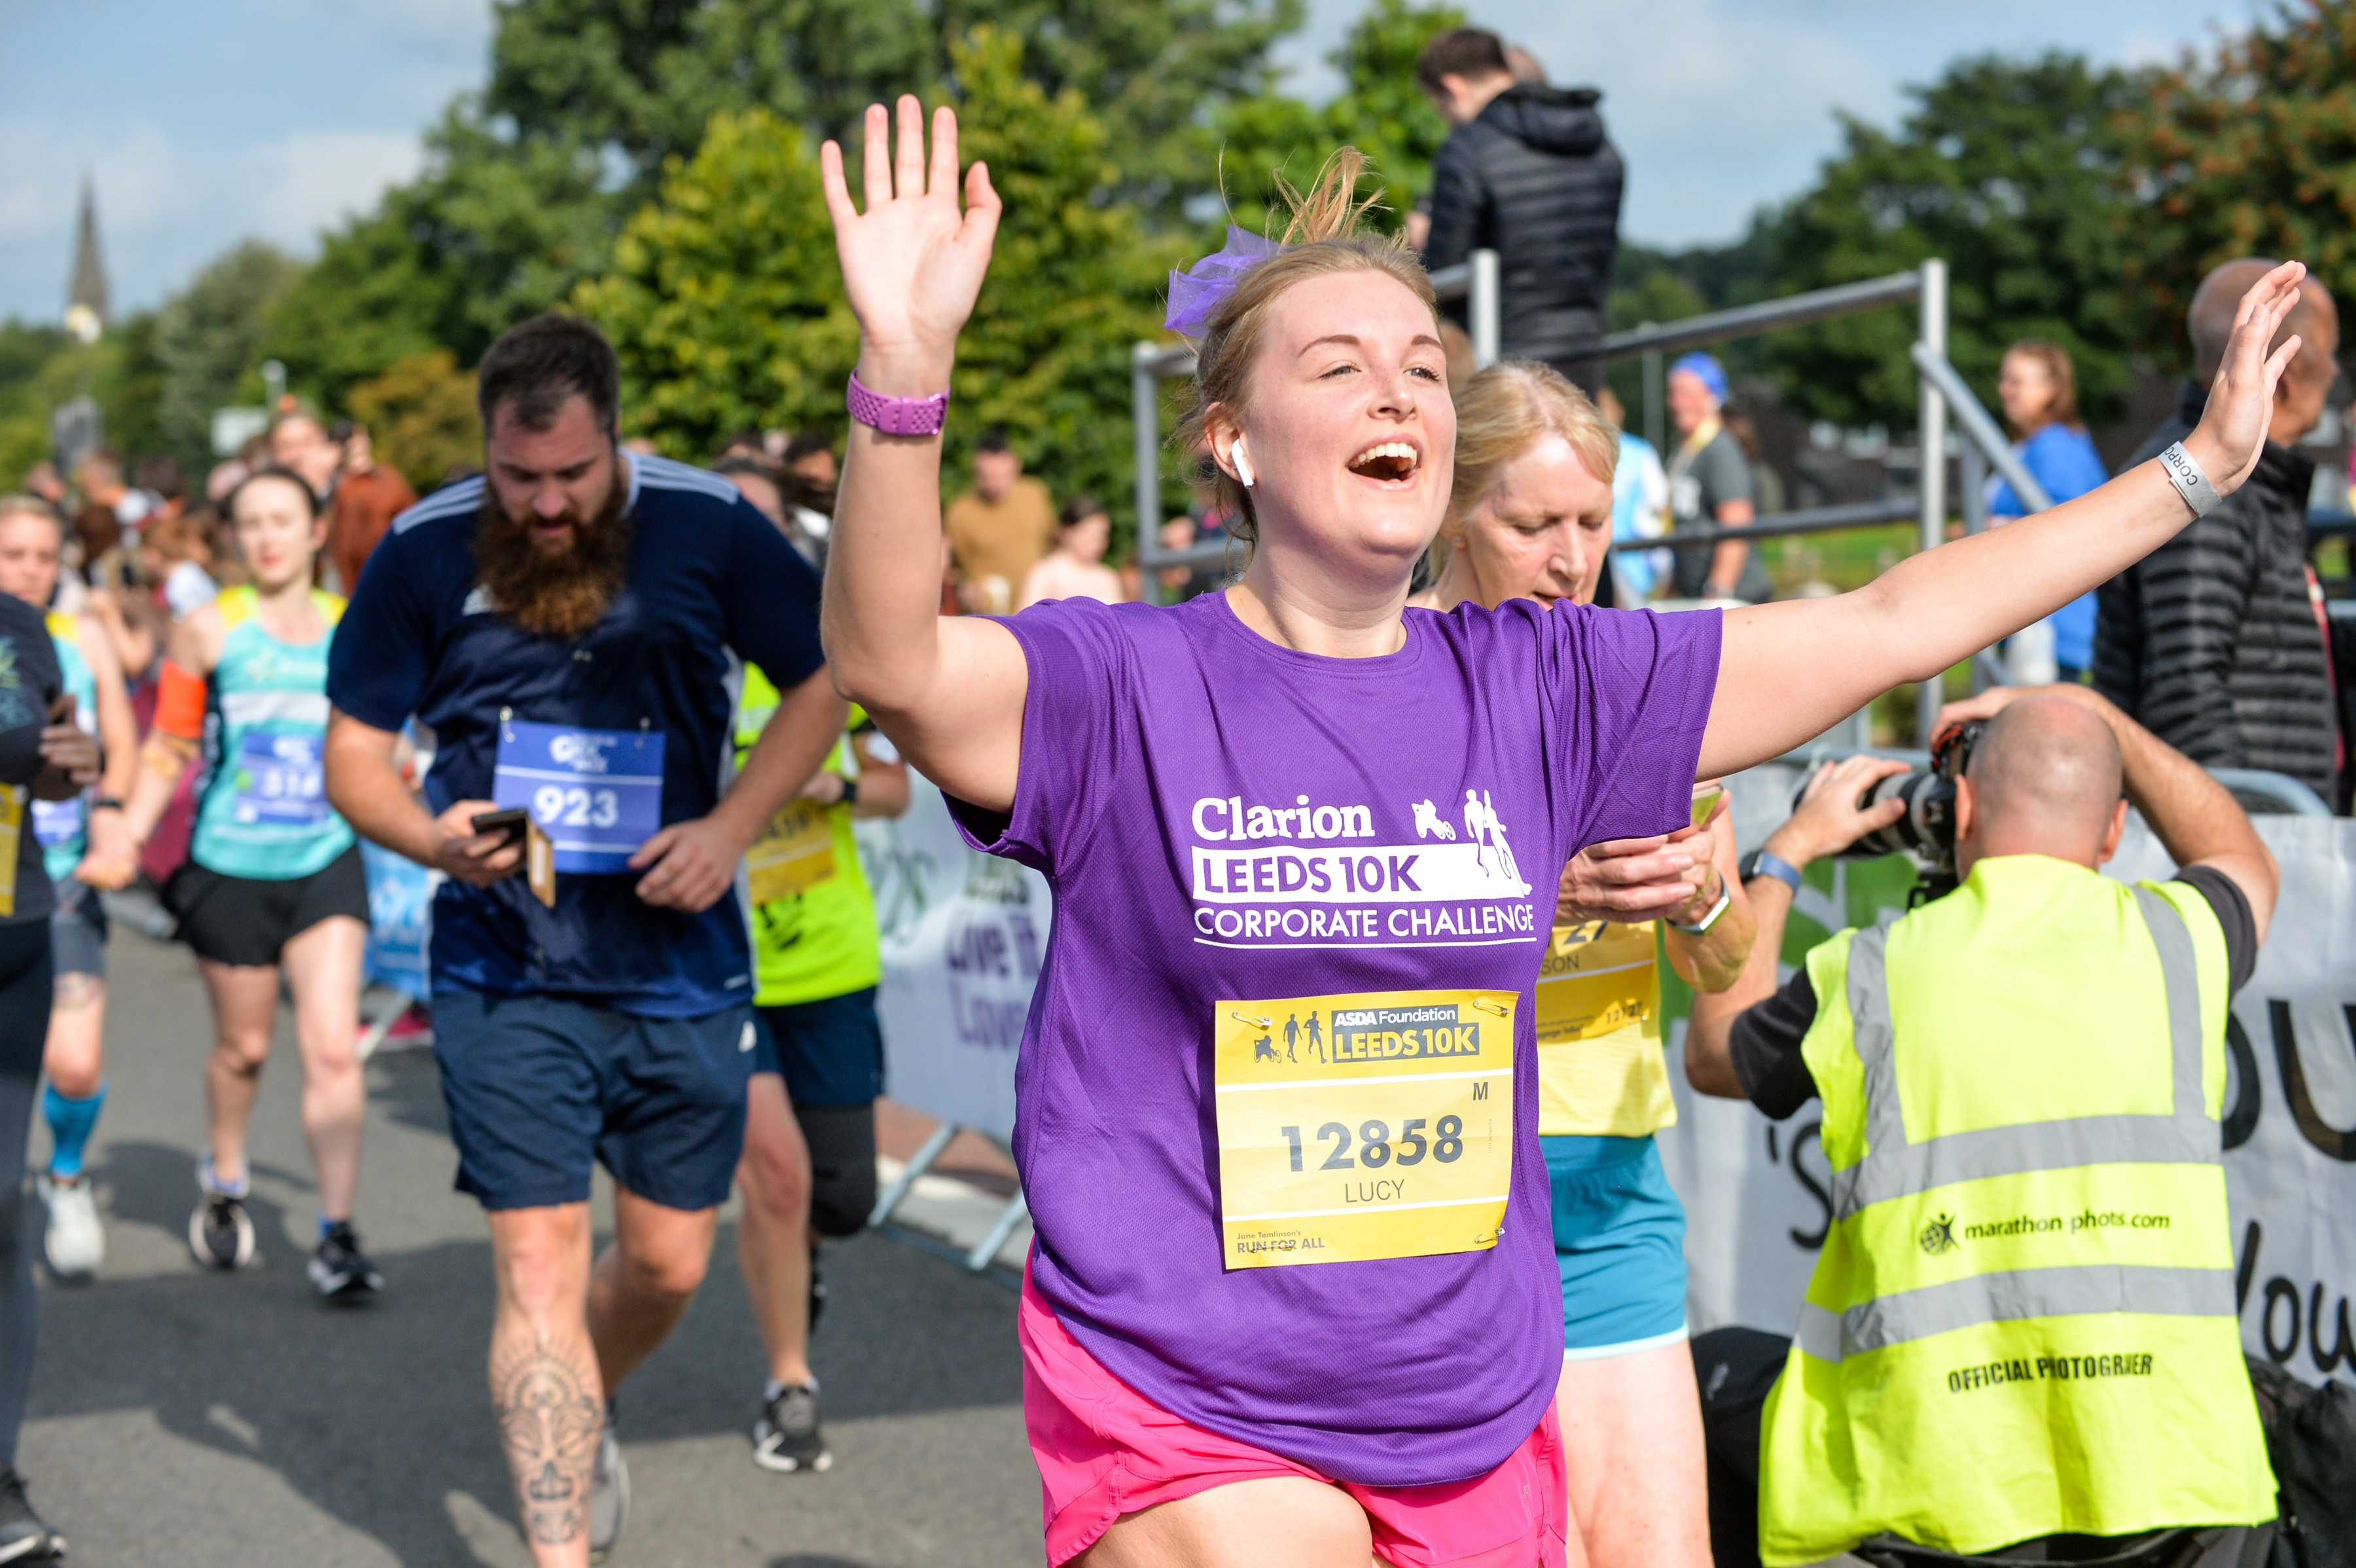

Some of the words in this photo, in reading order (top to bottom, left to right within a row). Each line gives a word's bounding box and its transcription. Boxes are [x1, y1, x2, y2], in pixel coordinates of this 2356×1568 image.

[535, 785, 618, 829] 923
[1191, 794, 1376, 841] Clarion
[1203, 855, 1331, 893] LEEDS
[1339, 854, 1422, 893] 10K
[1194, 907, 1378, 938] CORPORATE
[1387, 904, 1535, 936] CHALLENGE
[1334, 1011, 1378, 1027] ASDA
[1379, 1007, 1455, 1024] Foundation
[1335, 1029, 1420, 1060] LEEDS
[1422, 1026, 1477, 1054] 10K
[1473, 1082, 1488, 1101] M
[1281, 1114, 1464, 1172] 12858
[1345, 1179, 1405, 1203] LUCY
[1237, 1241, 1267, 1253] RUN
[1271, 1239, 1297, 1251] FOR
[1301, 1238, 1325, 1249] ALL
[1258, 1230, 1301, 1238] Tomlinson's
[1948, 1359, 2033, 1393] OFFICIAL
